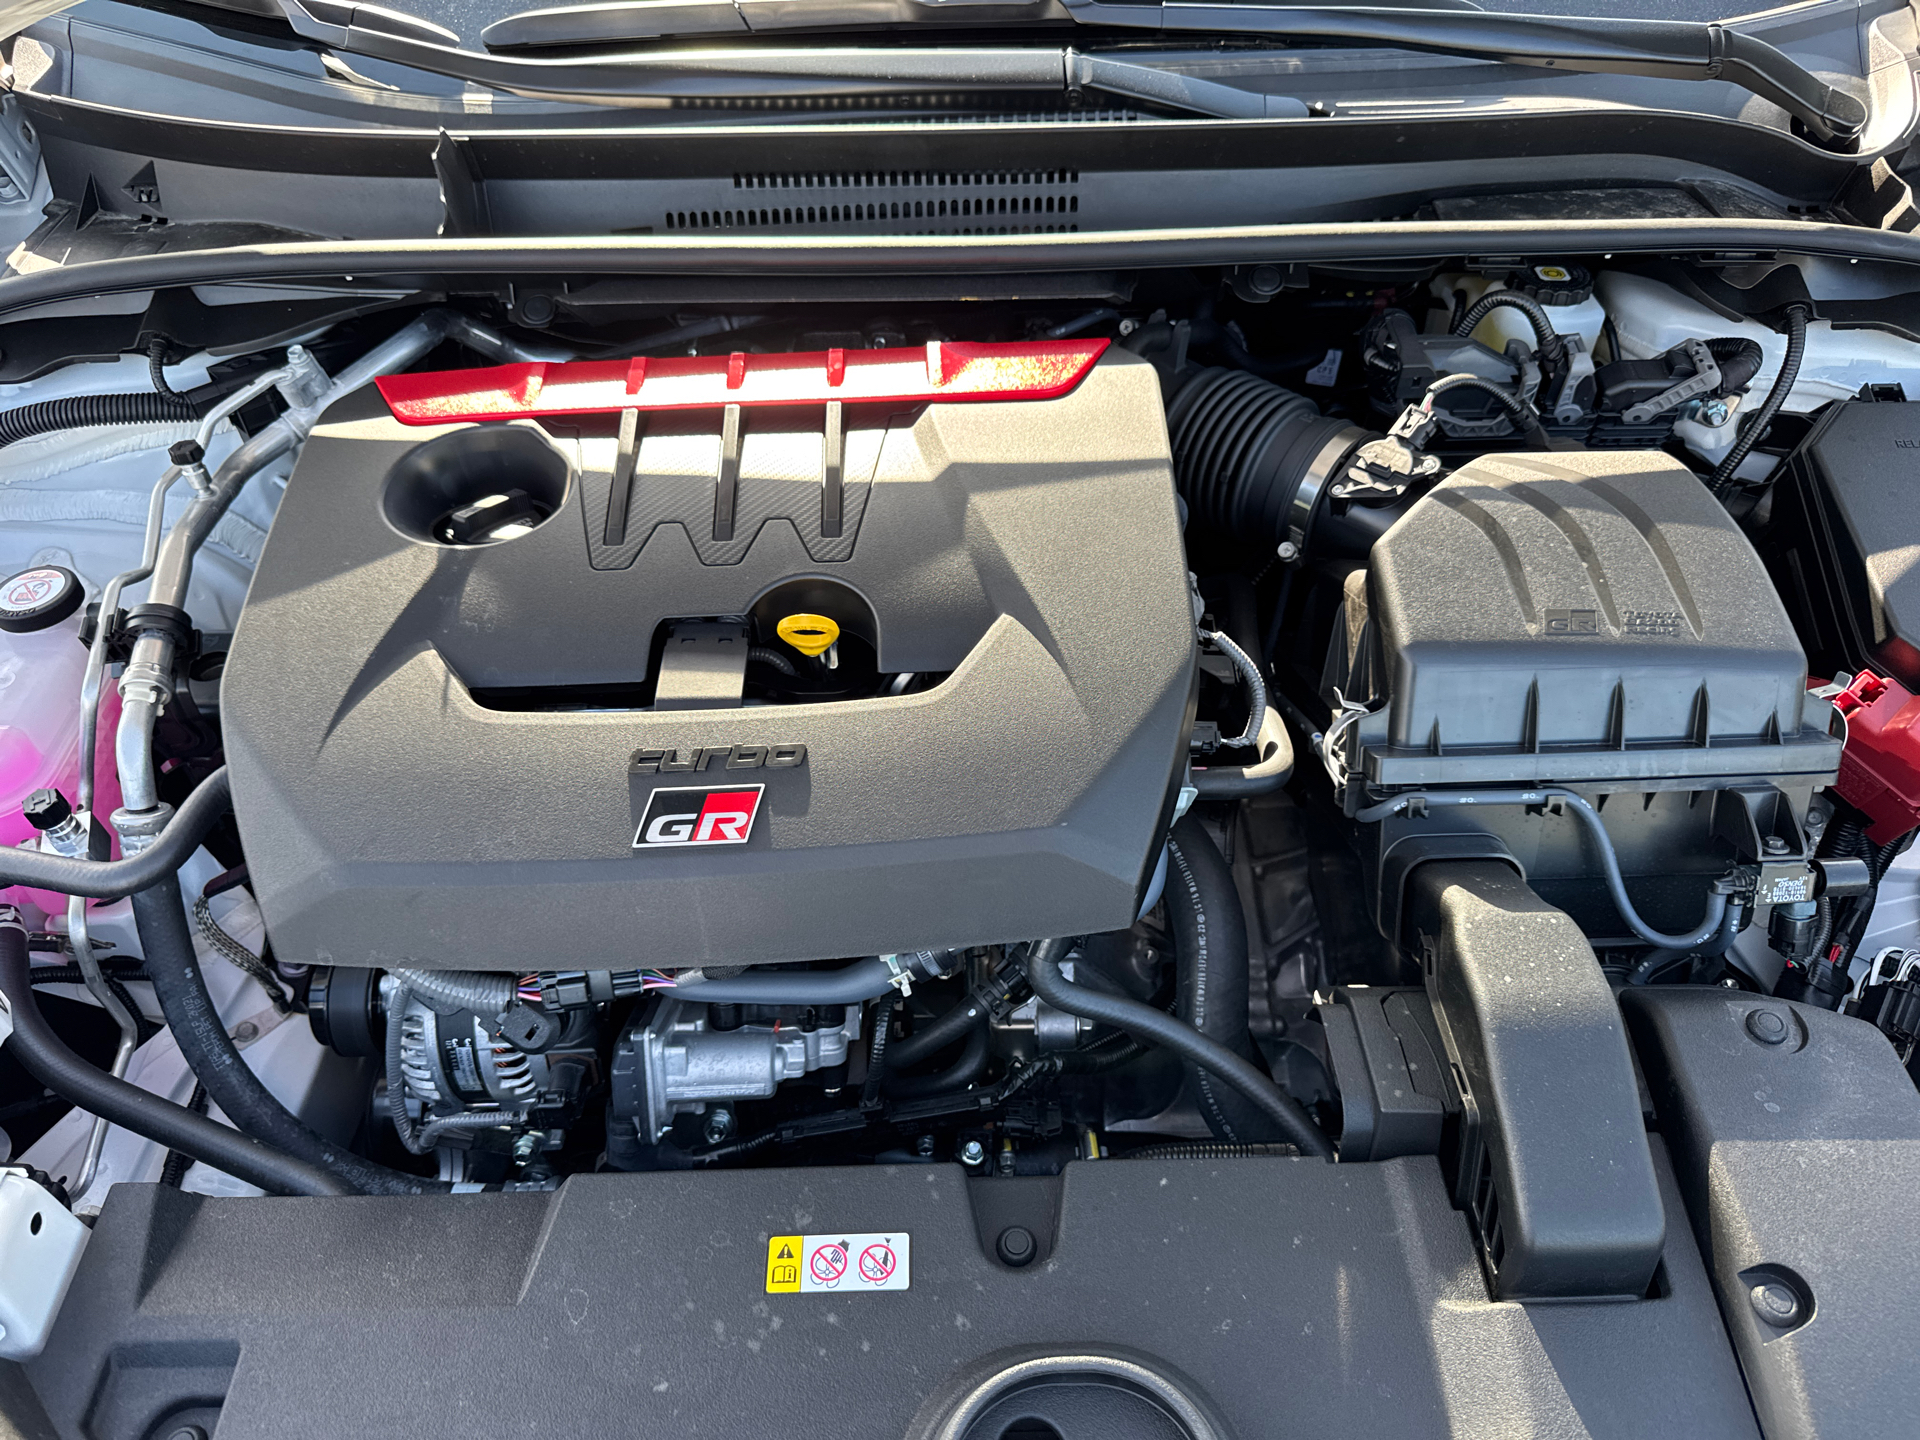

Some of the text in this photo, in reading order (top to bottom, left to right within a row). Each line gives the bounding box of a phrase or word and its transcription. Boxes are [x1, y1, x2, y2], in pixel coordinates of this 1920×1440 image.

[1894, 439, 1920, 449] REL
[1547, 616, 1598, 633] GR
[645, 811, 749, 843] GR
[1772, 894, 1805, 903] TOYOTA
